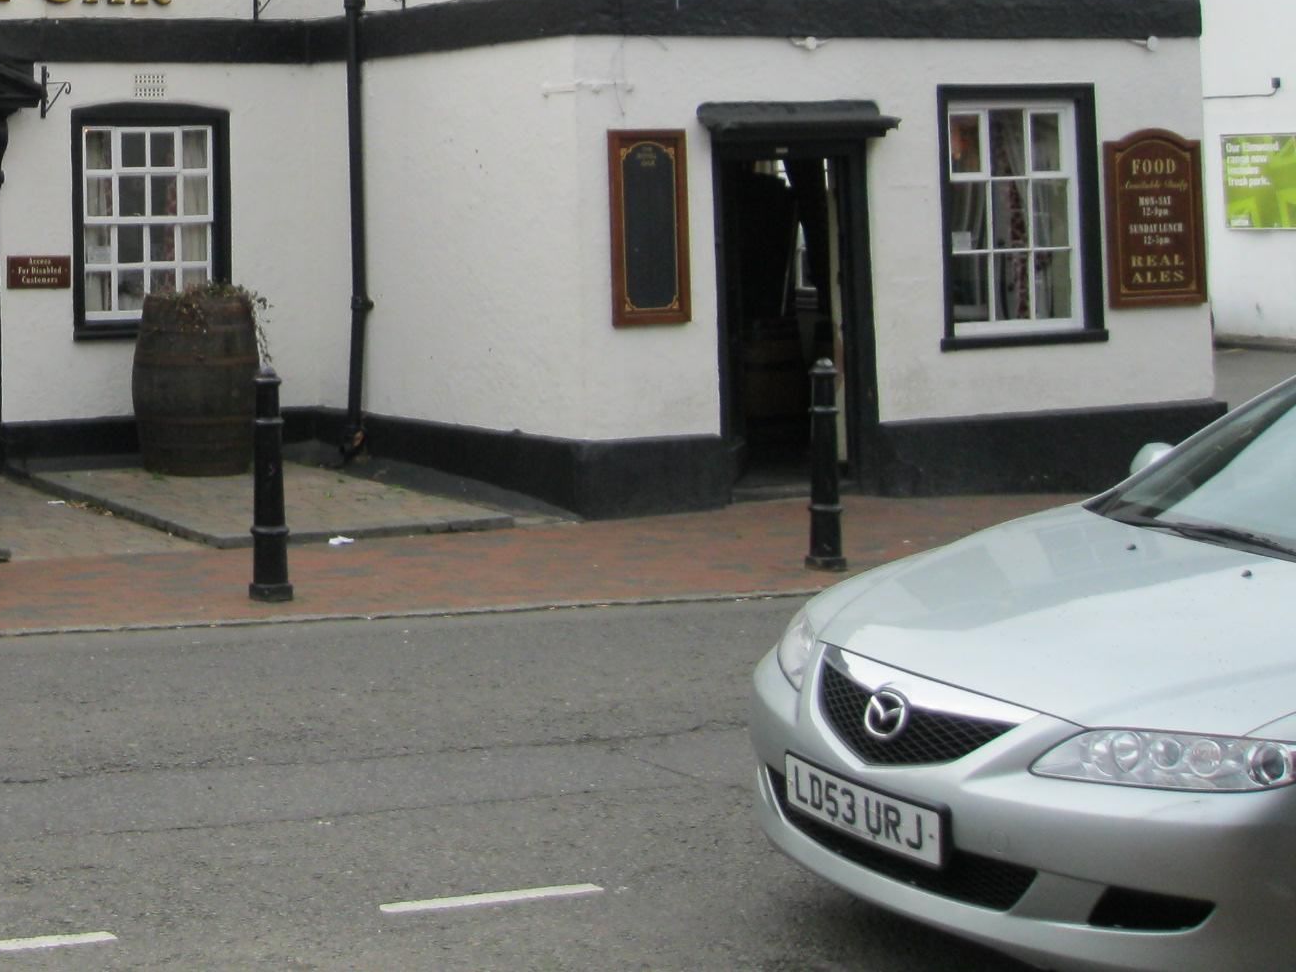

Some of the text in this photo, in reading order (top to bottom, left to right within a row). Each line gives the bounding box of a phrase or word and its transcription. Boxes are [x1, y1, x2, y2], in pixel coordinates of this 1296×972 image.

[1250, 155, 1268, 164] now
[1132, 158, 1176, 175] FOOD
[1128, 222, 1183, 234] SUNDAY LUNCH
[28, 257, 52, 266] Access
[1130, 253, 1185, 268] REAL
[17, 265, 62, 275] For Disabled
[21, 275, 59, 284] Customers
[1132, 270, 1185, 284] ALES
[794, 764, 923, 850] LD53 URJ
